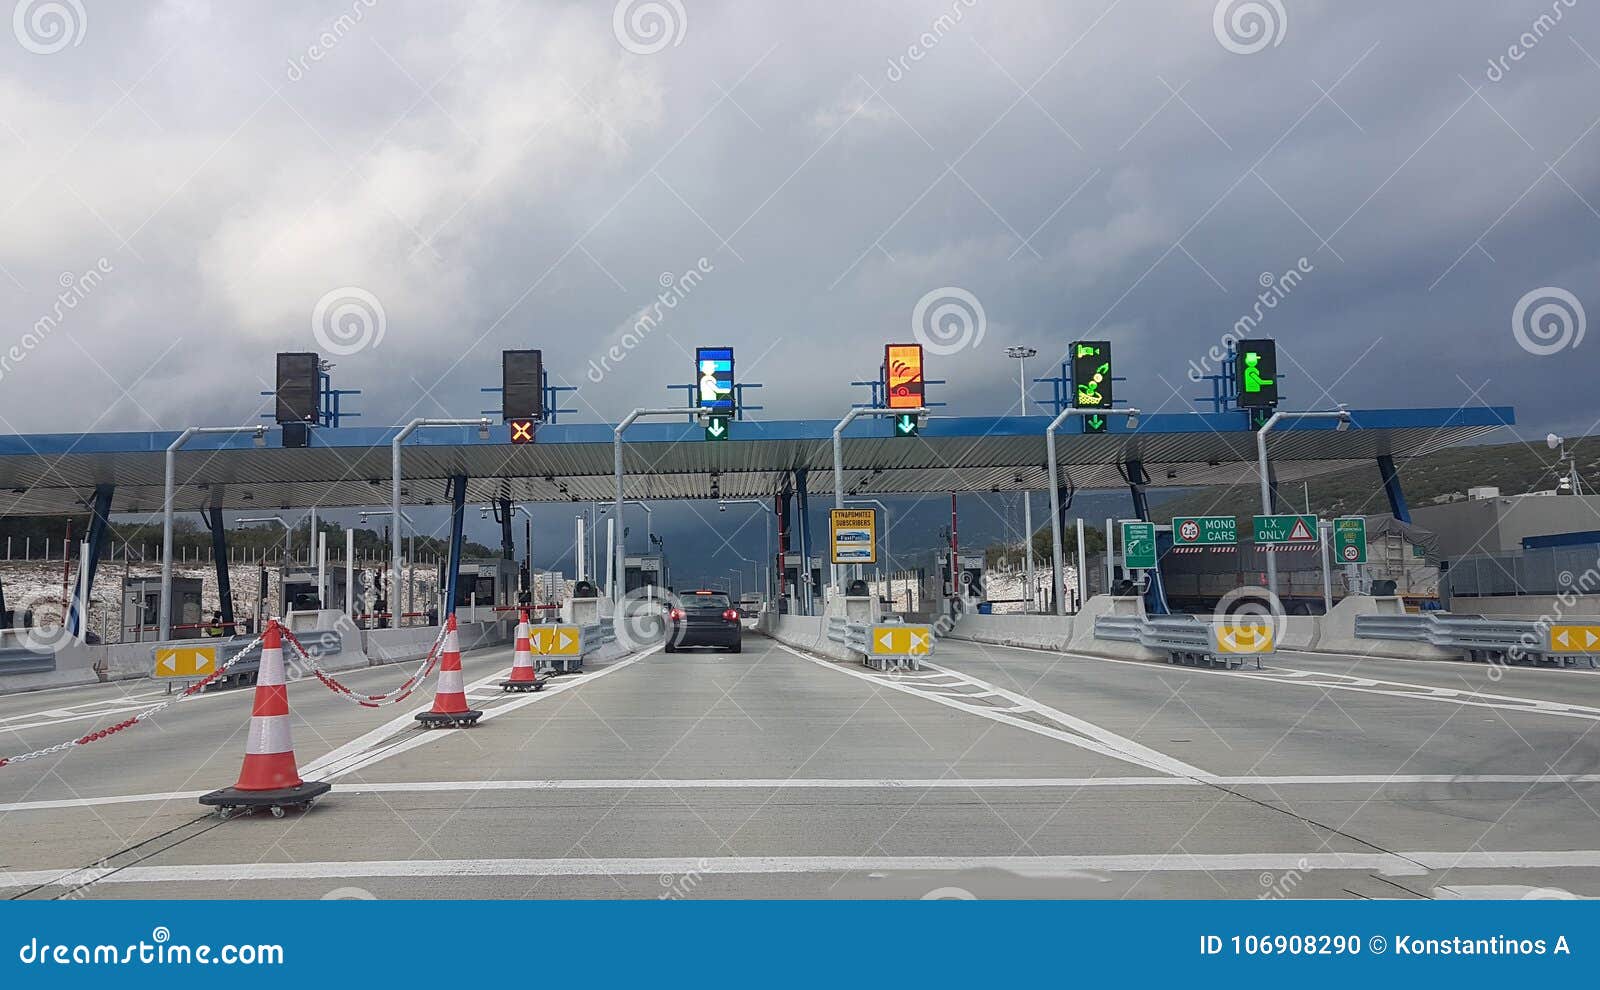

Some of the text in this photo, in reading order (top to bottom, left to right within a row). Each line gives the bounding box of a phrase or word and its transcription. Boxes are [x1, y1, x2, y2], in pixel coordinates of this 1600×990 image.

[1207, 531, 1236, 541] CARS
[1259, 530, 1286, 540] ONLY
[1346, 549, 1356, 557] 20
